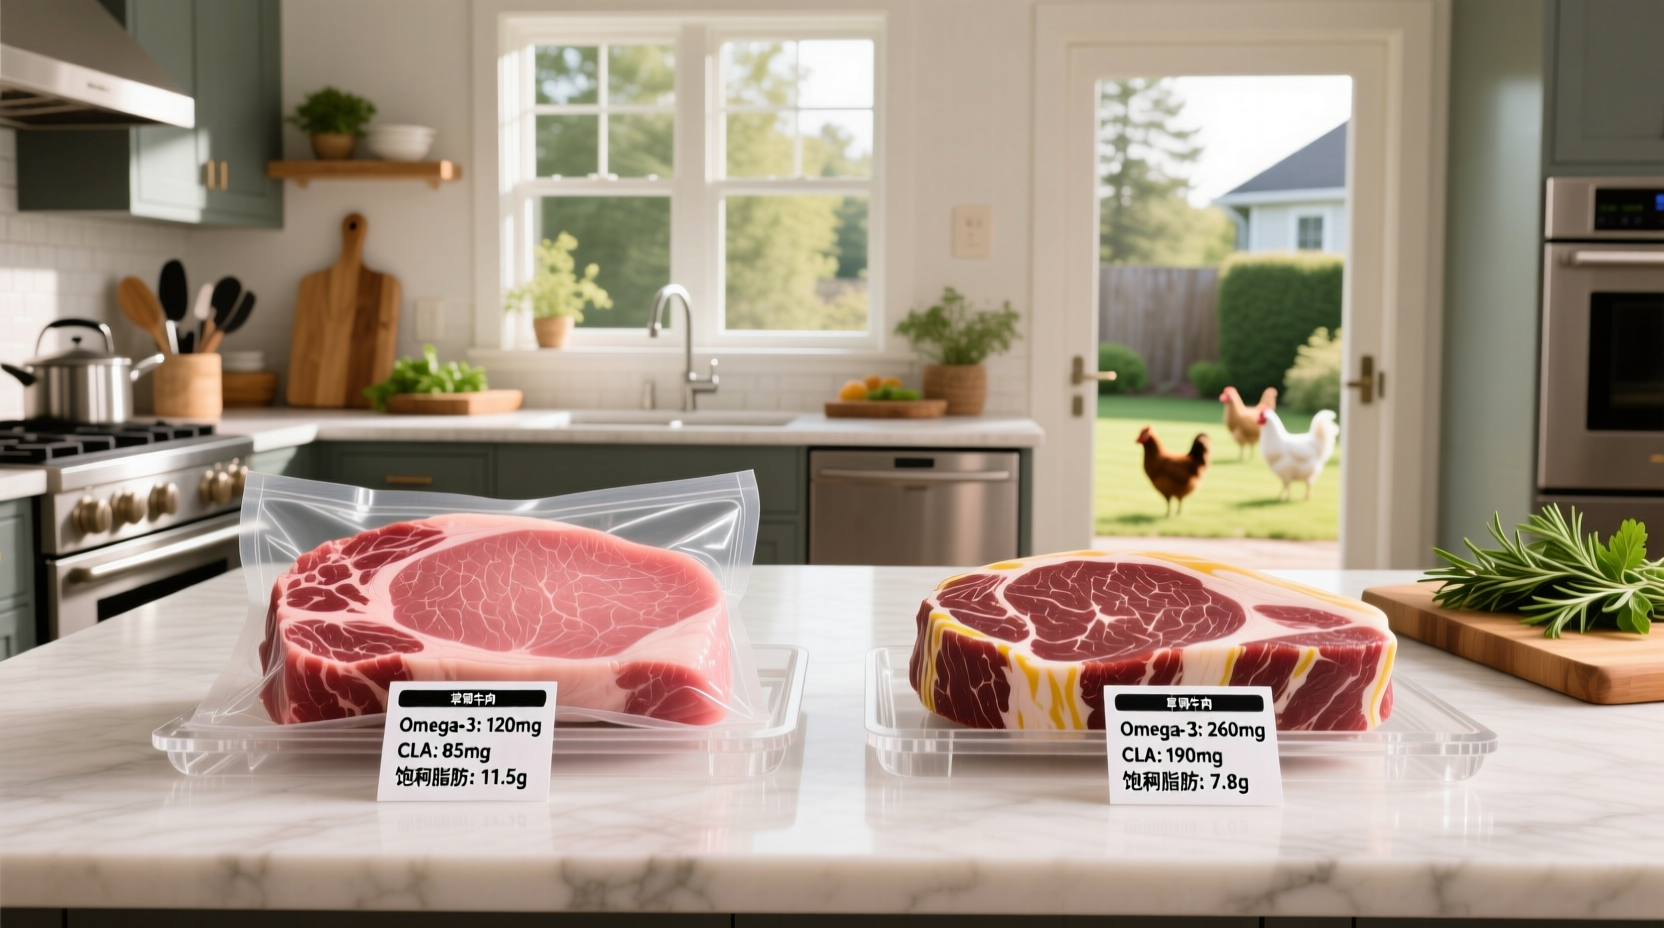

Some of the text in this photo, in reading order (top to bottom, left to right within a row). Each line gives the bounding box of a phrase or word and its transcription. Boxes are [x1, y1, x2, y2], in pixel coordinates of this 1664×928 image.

[399, 716, 542, 738] Omega-3: 120mg
[1120, 720, 1266, 743] Omega-3: 260mg
[397, 741, 491, 764] CLA: 85mg
[1121, 746, 1223, 768] CLA: 190mg
[481, 768, 528, 790] 11.5g
[1210, 773, 1249, 795] 7.8g
